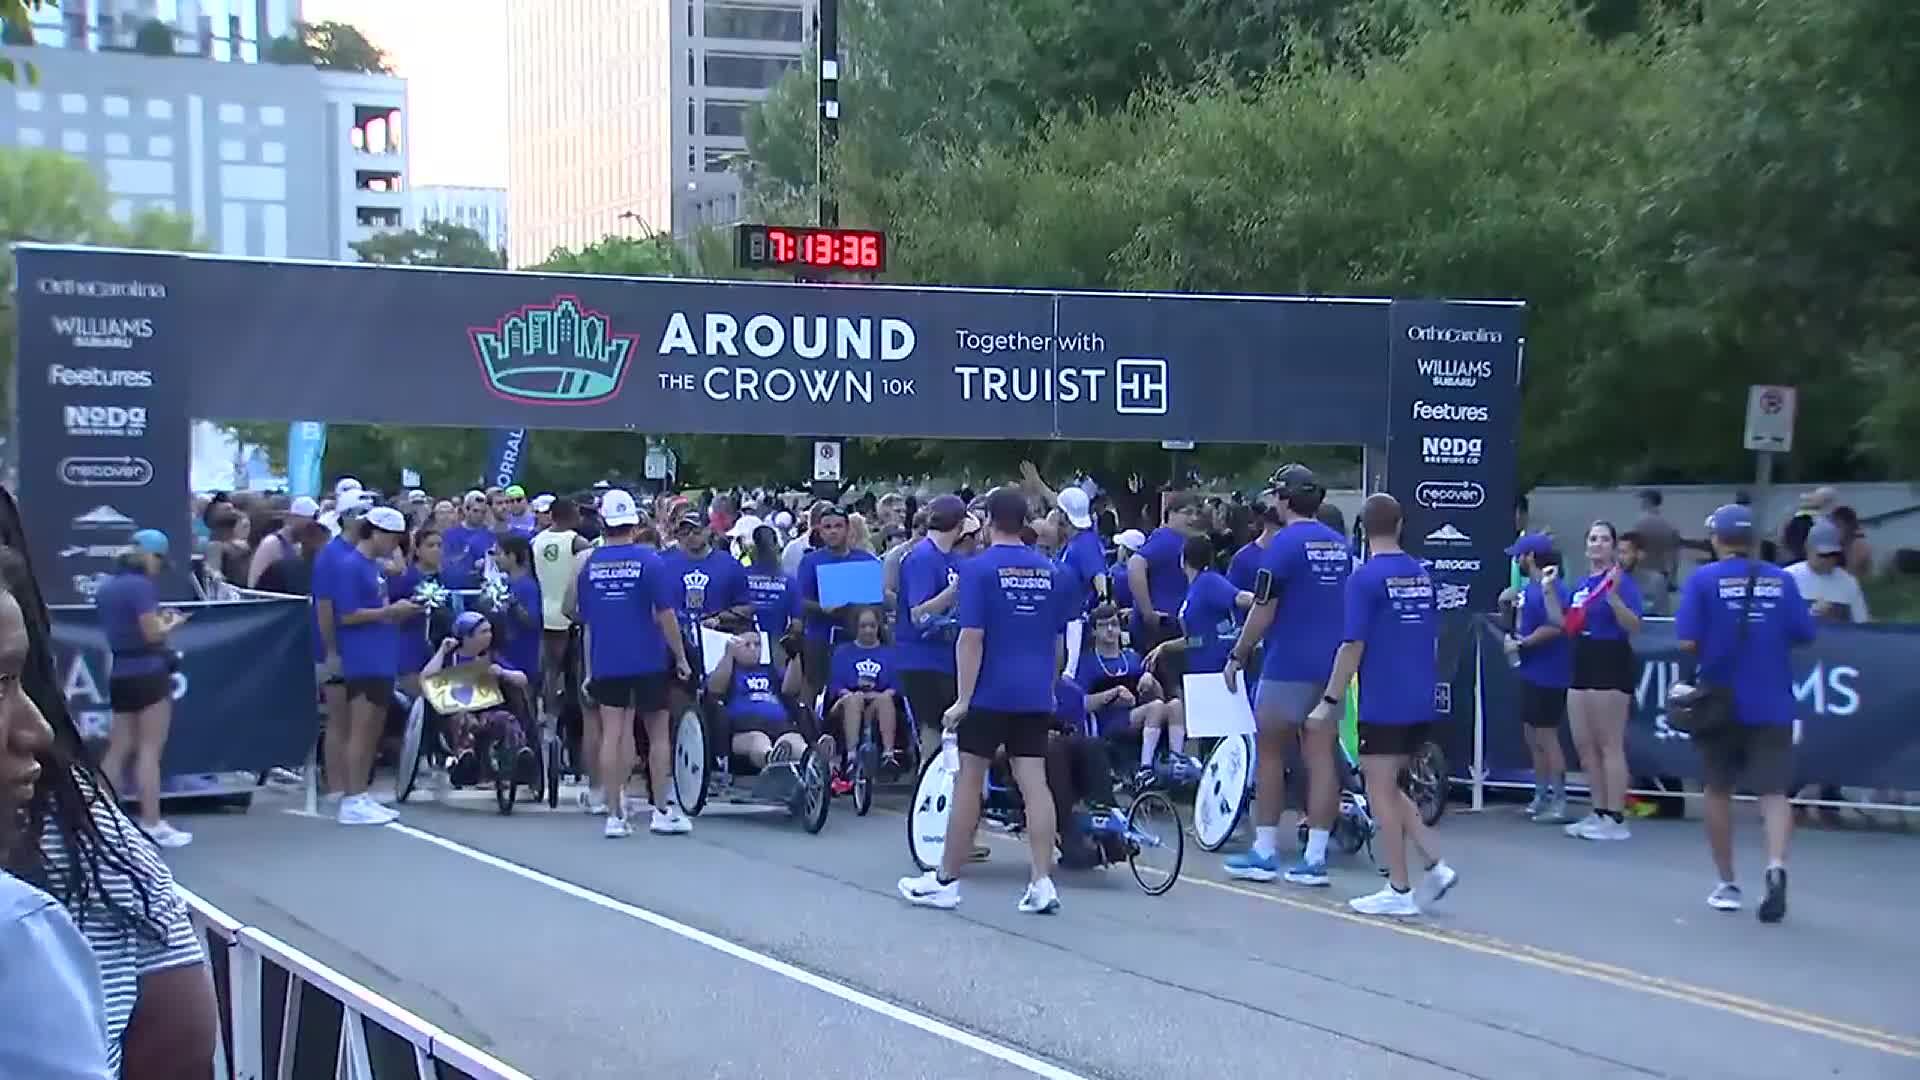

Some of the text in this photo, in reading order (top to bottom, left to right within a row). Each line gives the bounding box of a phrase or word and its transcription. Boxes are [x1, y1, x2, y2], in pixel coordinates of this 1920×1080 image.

[769, 231, 878, 267] 7:13:36
[52, 316, 154, 338] WILLIAMS
[658, 311, 917, 361] AROUND
[955, 329, 1106, 354] Together with
[658, 366, 918, 403] THE CROWN 10K
[954, 366, 1106, 402] TRUIST
[1417, 358, 1492, 378] WILLIAMS
[497, 427, 525, 489] ORRAL
